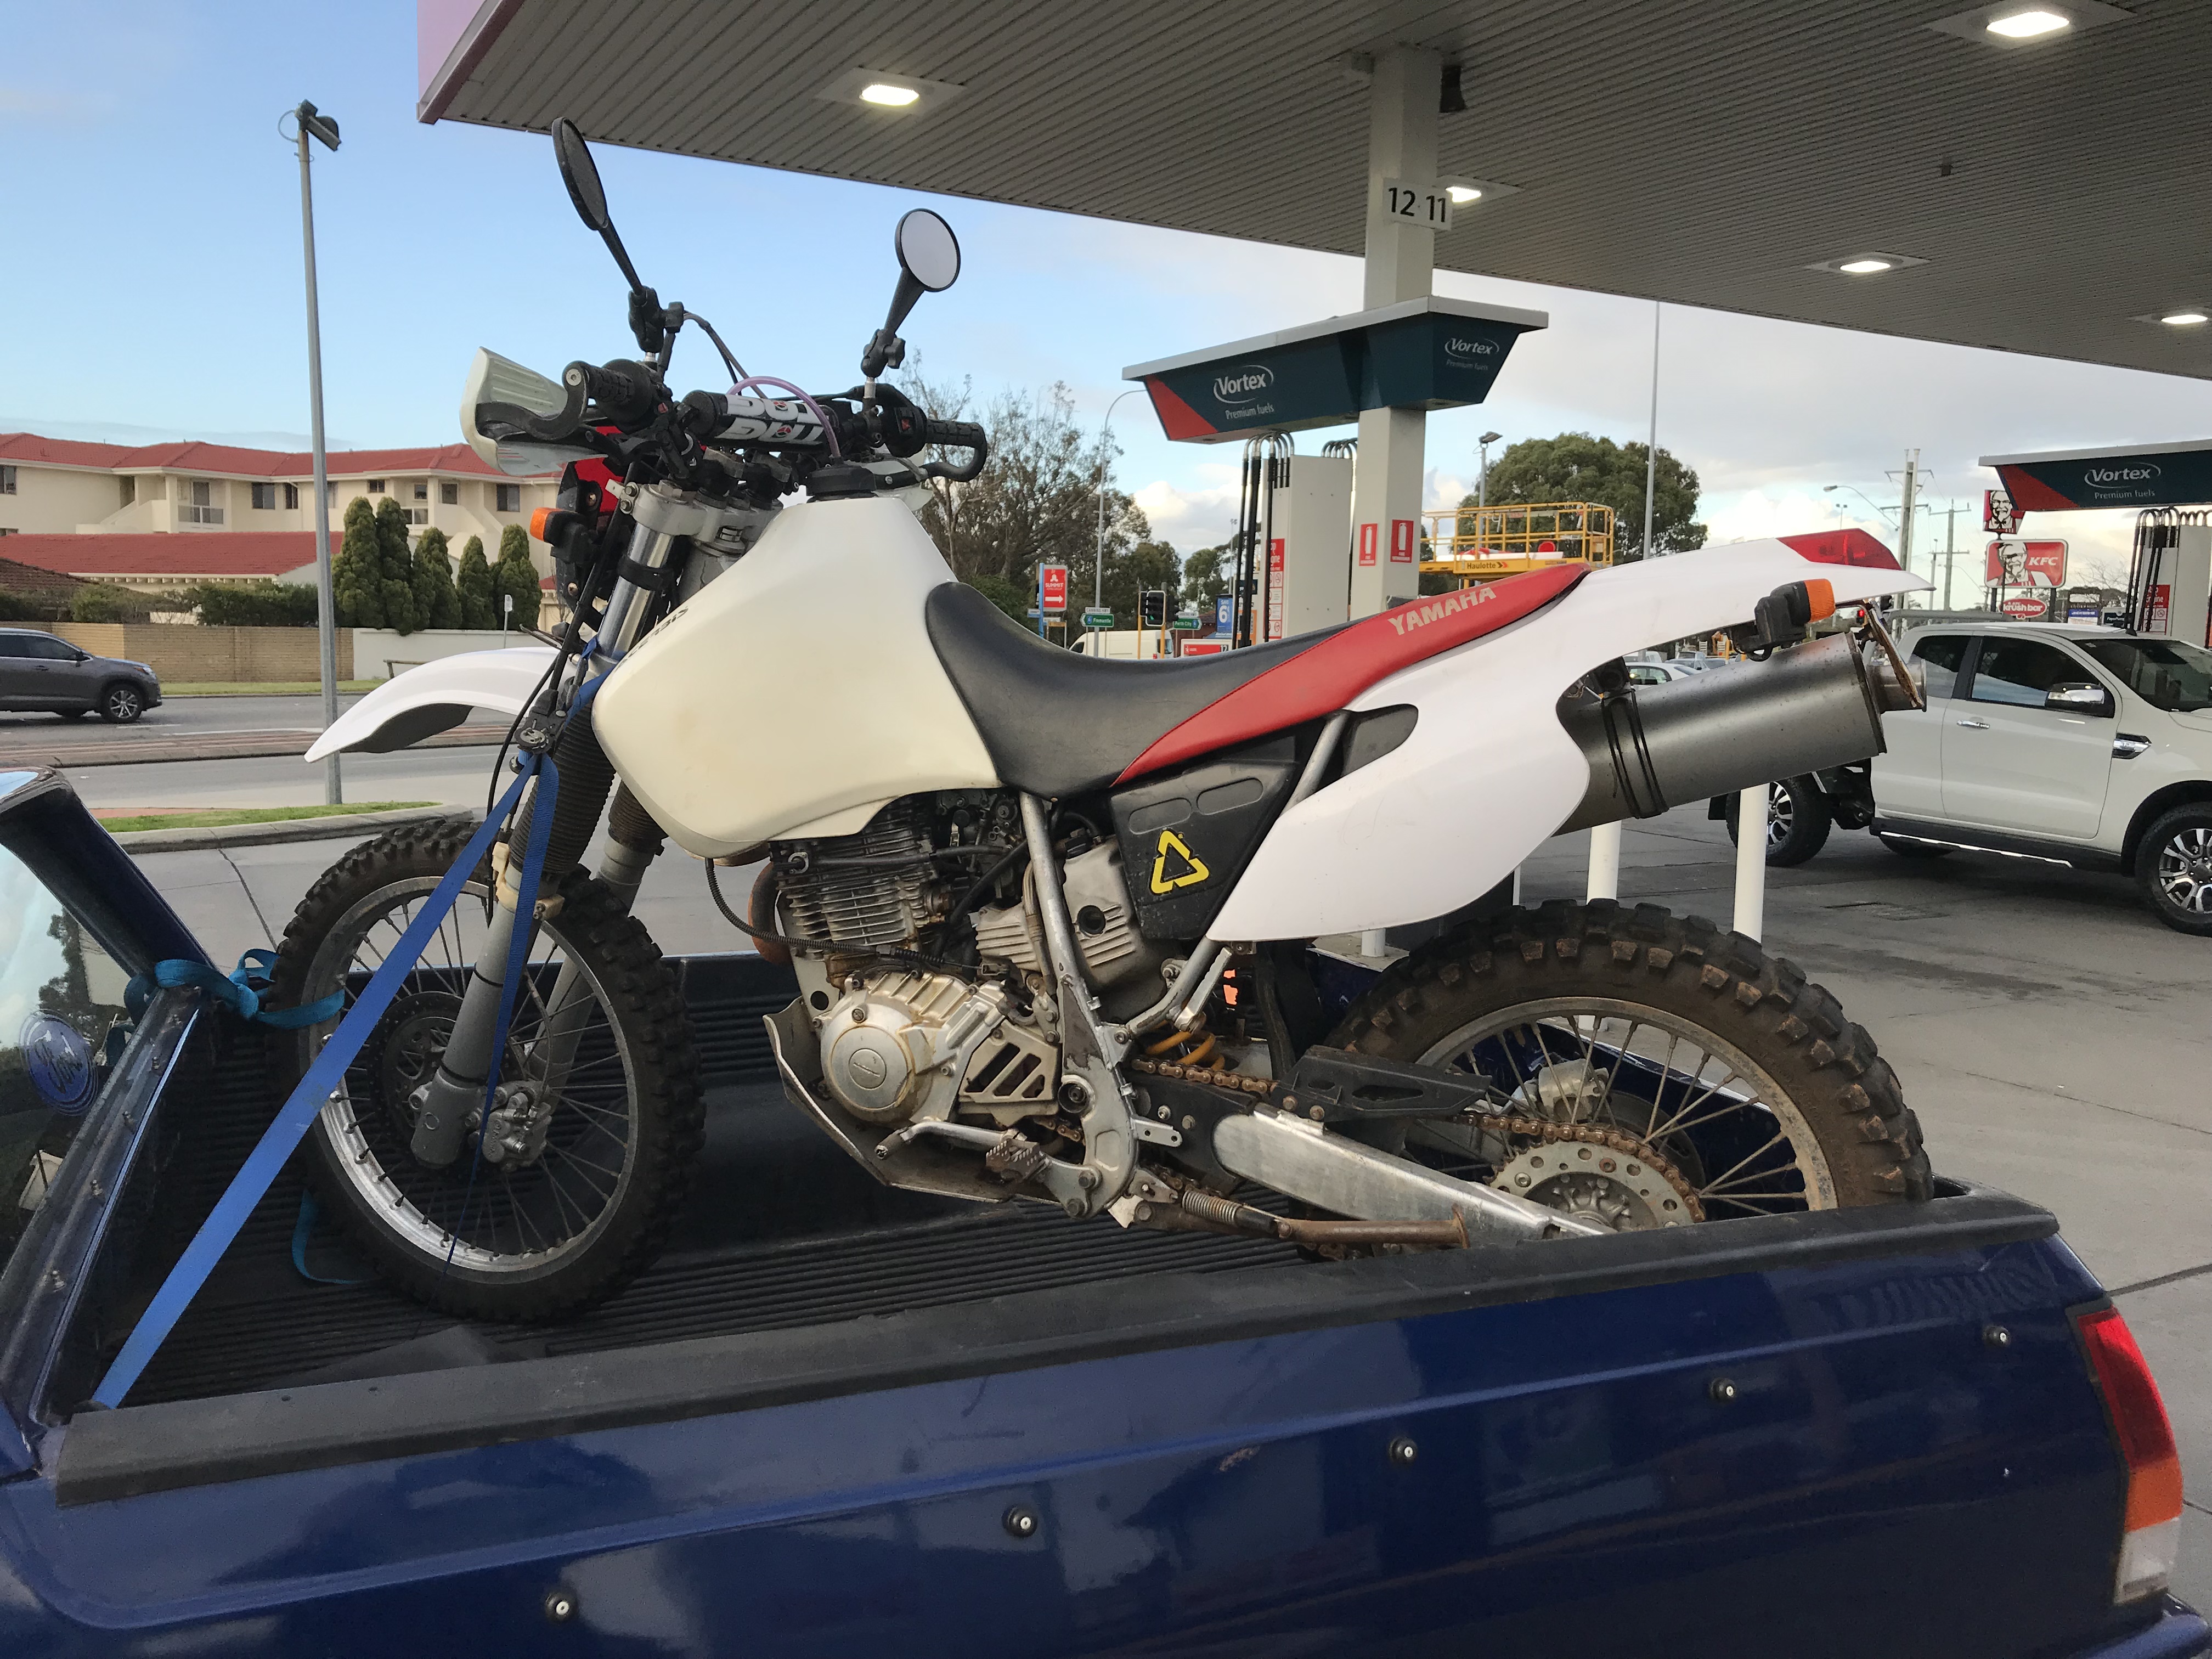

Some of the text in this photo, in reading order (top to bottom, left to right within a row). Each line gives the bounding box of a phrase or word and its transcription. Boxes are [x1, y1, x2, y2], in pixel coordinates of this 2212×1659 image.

[1388, 187, 1446, 222] 12 11
[1451, 337, 1492, 354] Vortex
[1215, 373, 1266, 395] Vortex
[1225, 403, 1274, 420] Premium fuels
[2089, 468, 2151, 482] Vortex
[2095, 490, 2132, 499] Premium
[2028, 557, 2059, 566] KFC
[1219, 605, 1227, 623] 6
[1387, 587, 1497, 635] YAMAHA
[2003, 603, 2027, 612] krush
